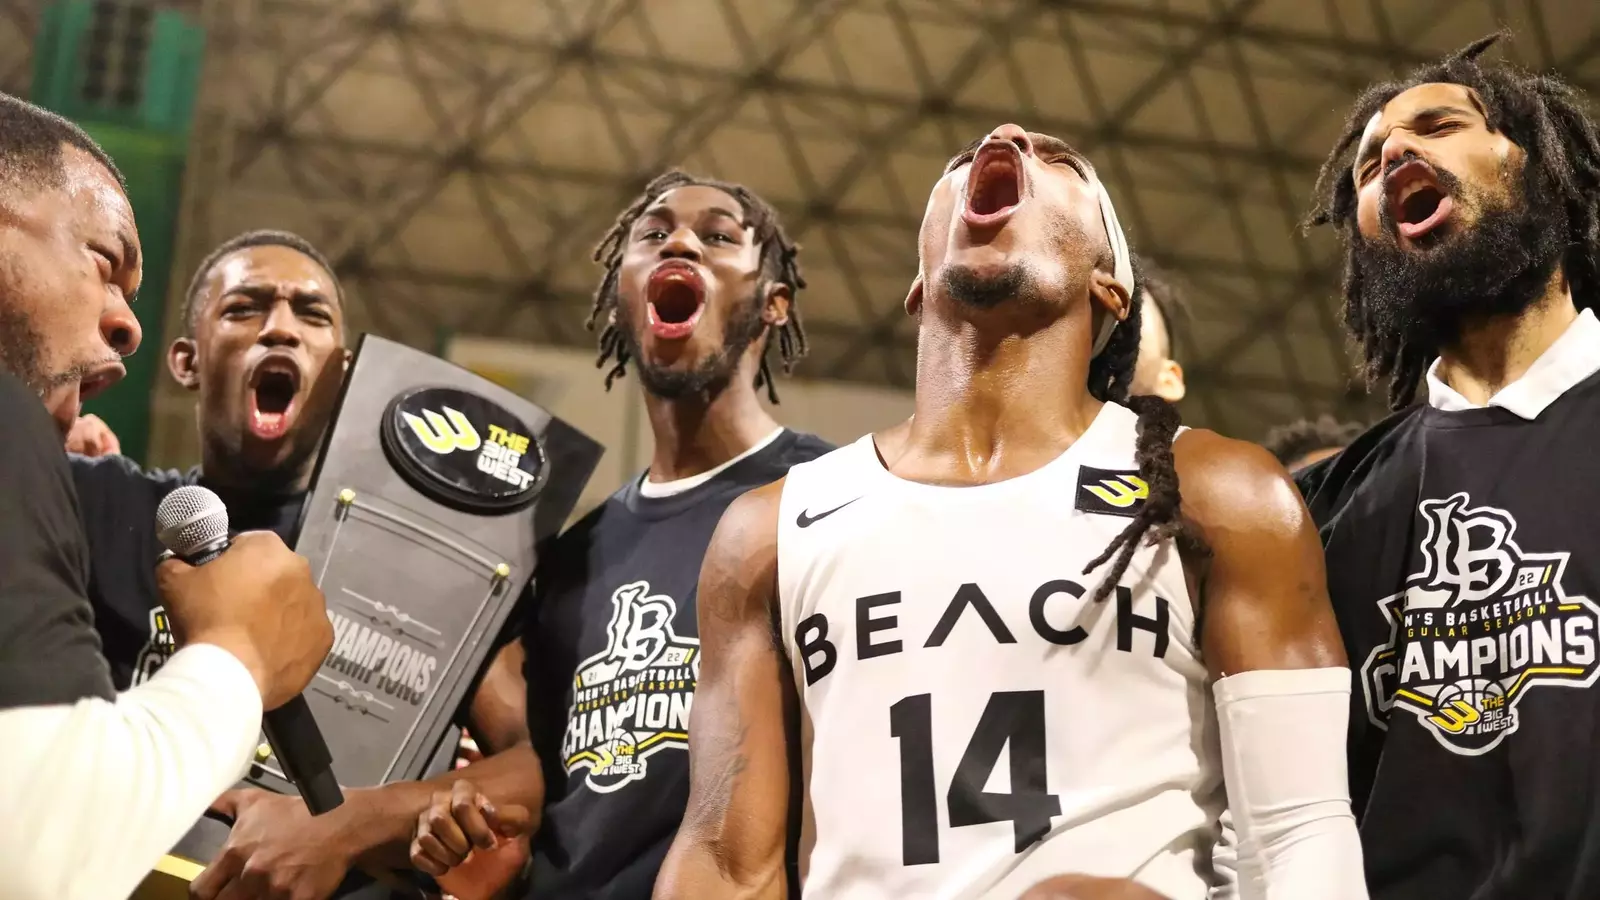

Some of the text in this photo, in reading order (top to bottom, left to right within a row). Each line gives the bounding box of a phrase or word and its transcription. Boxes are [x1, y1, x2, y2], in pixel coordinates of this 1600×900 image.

[487, 424, 530, 455] THE
[482, 440, 522, 468] BIG
[477, 454, 535, 489] WEST
[1519, 572, 1534, 586] 22
[1404, 589, 1554, 628] N'S BASKETBALL
[1408, 605, 1546, 638] GULAR SEASON
[326, 609, 437, 693] HAMPIONS
[667, 652, 681, 663] 22
[1373, 616, 1596, 712] CAMPIONS
[577, 684, 610, 703] MEN'S
[1481, 696, 1504, 710] THE
[562, 692, 694, 761] CHAMPION
[1482, 715, 1512, 732] WEST
[1483, 708, 1503, 722] BIG
[616, 745, 635, 756] THE
[612, 763, 641, 775] WEST
[890, 690, 1062, 866] 14
